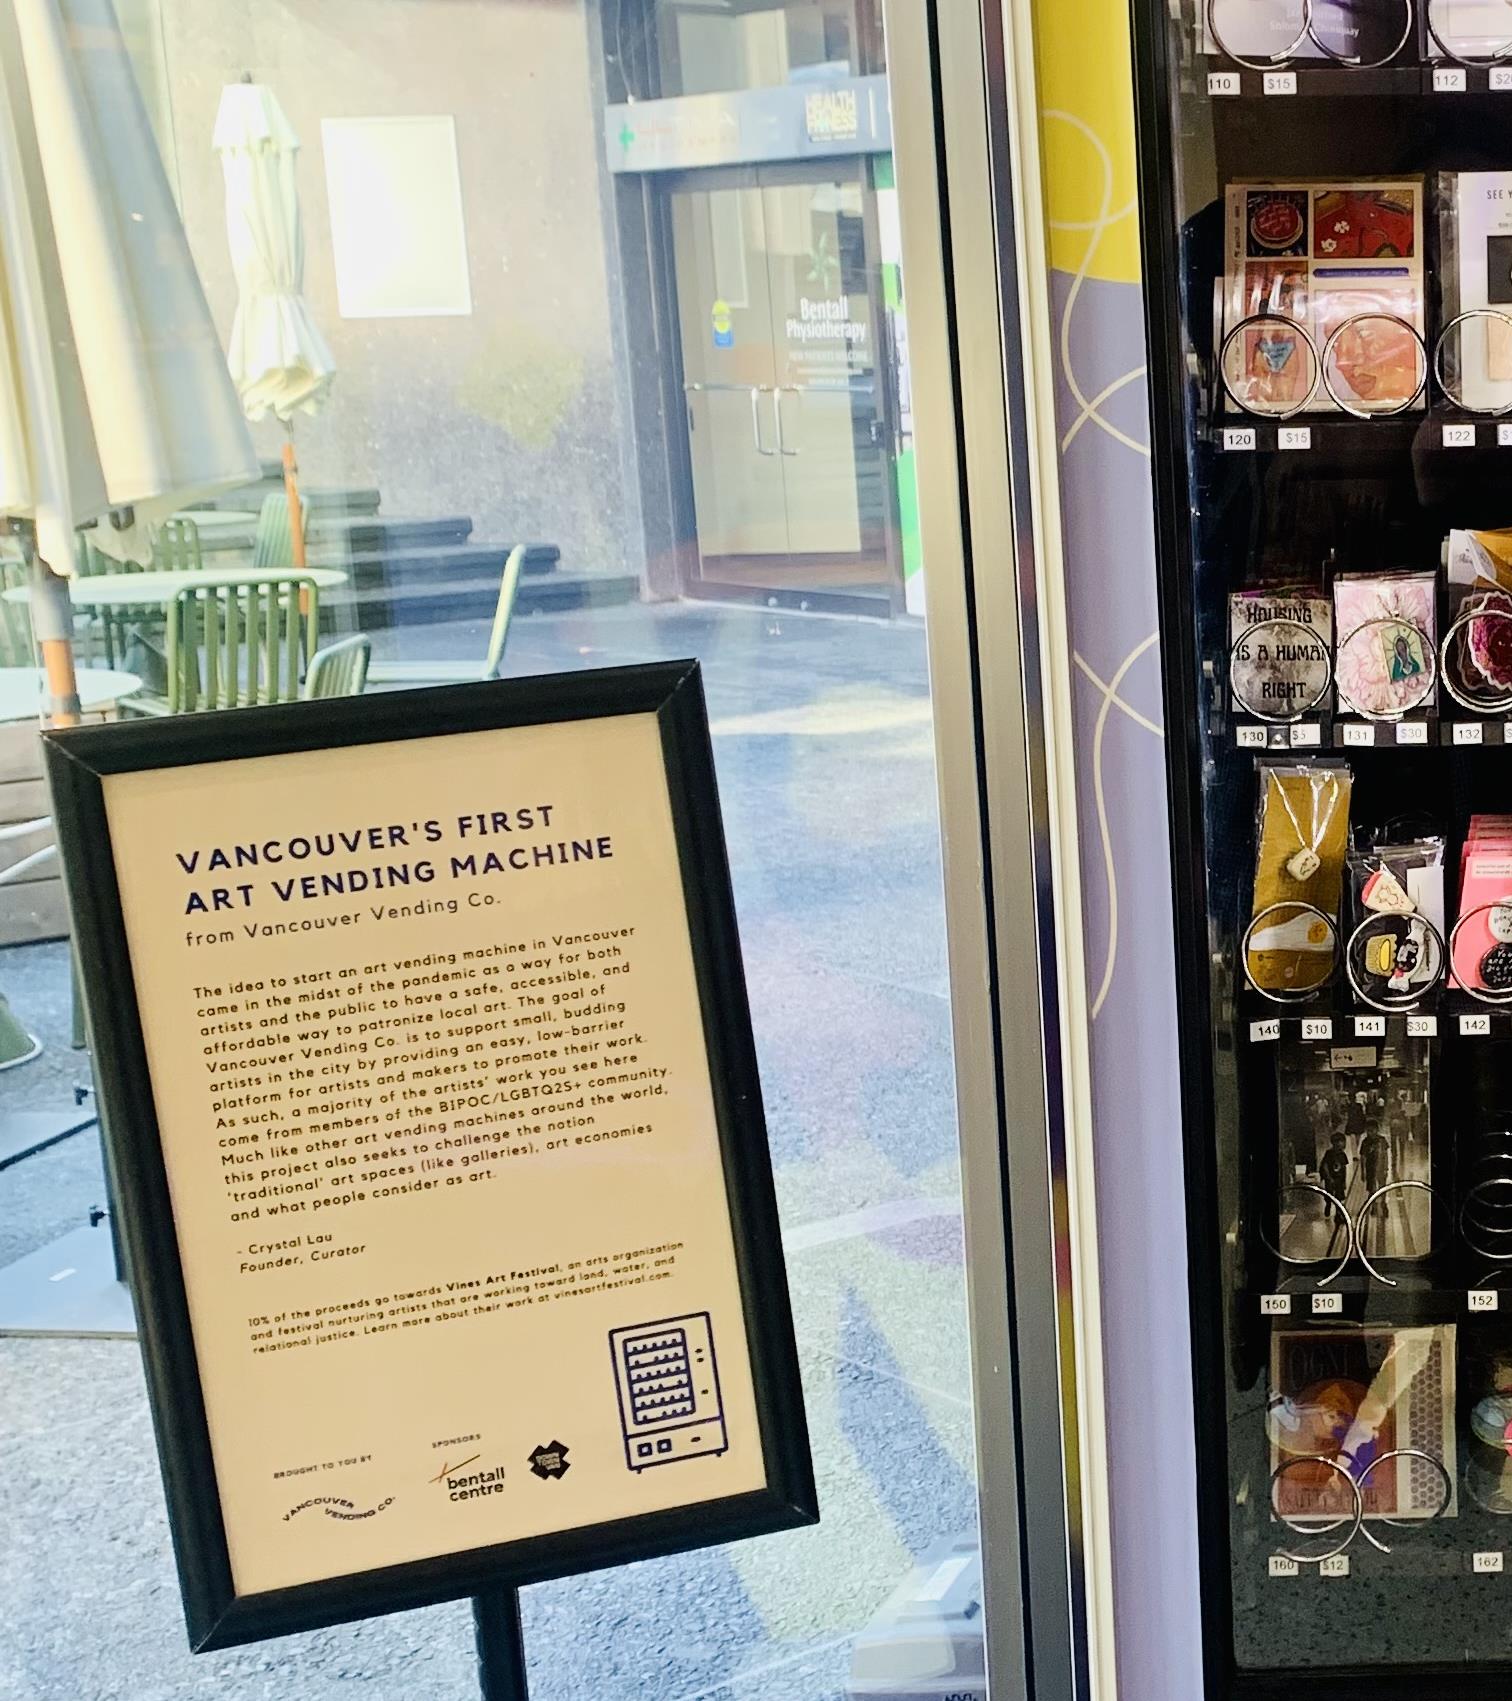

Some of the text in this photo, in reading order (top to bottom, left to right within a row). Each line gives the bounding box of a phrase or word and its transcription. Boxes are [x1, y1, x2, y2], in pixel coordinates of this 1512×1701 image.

[1209, 78, 1231, 90] 110
[1268, 78, 1290, 90] $15
[1436, 75, 1457, 86] 112
[1487, 189, 1503, 199] SEE
[800, 295, 848, 320] Bentall
[786, 318, 865, 343] Physiotherapy
[1228, 434, 1251, 445] 120
[1286, 432, 1308, 444] $15
[1448, 430, 1470, 441] 122
[1247, 604, 1312, 623] HOUSING
[1236, 645, 1250, 660] IS
[1258, 645, 1268, 660] A
[1262, 682, 1306, 698] RIGHT
[1242, 731, 1264, 742] 130
[1348, 730, 1367, 741] 131
[1459, 729, 1480, 739] 132
[174, 804, 556, 876] VANCOUVER'S FIRST
[180, 835, 614, 916] ART VENDING MACHINE
[184, 888, 501, 947] from Vancouver Vending Co.
[191, 924, 636, 1000] The idea to start an art vending machine in Vancouver
[198, 961, 631, 1037] artists and the public to have a safe, accessible, and
[1258, 1025, 1279, 1036] 140
[1306, 1024, 1328, 1035] $10
[1359, 1022, 1379, 1031] 141
[1408, 1021, 1428, 1032] $30
[1465, 1020, 1486, 1030] 142
[205, 998, 626, 1074] Vancouver Vending Co. is to support small, budding
[217, 1064, 673, 1148] come from members of the BIPOC/LGBTQ2S+ community.
[247, 1230, 333, 1257] Crystal Lau
[238, 1241, 367, 1275] Founder, Curator
[247, 1314, 271, 1328] 10%
[272, 1311, 288, 1324] of
[289, 1307, 311, 1320] the
[313, 1297, 371, 1317] proceeds
[373, 1295, 391, 1307] go
[392, 1284, 443, 1302] towards
[444, 1276, 482, 1293] Vines
[484, 1272, 507, 1286] Art
[566, 1260, 582, 1270] an
[584, 1254, 609, 1267] arts
[610, 1240, 685, 1264] organization
[1265, 1299, 1287, 1310] 150
[1314, 1298, 1334, 1309] $10
[1472, 1296, 1493, 1306] 152
[447, 1467, 505, 1490] bentall
[450, 1483, 503, 1501] centre
[282, 1497, 354, 1521] VANCOUVER
[324, 1508, 376, 1520] VENDING
[1274, 1560, 1294, 1570] 160
[1322, 1560, 1343, 1570] $12
[1478, 1557, 1498, 1567] 162
